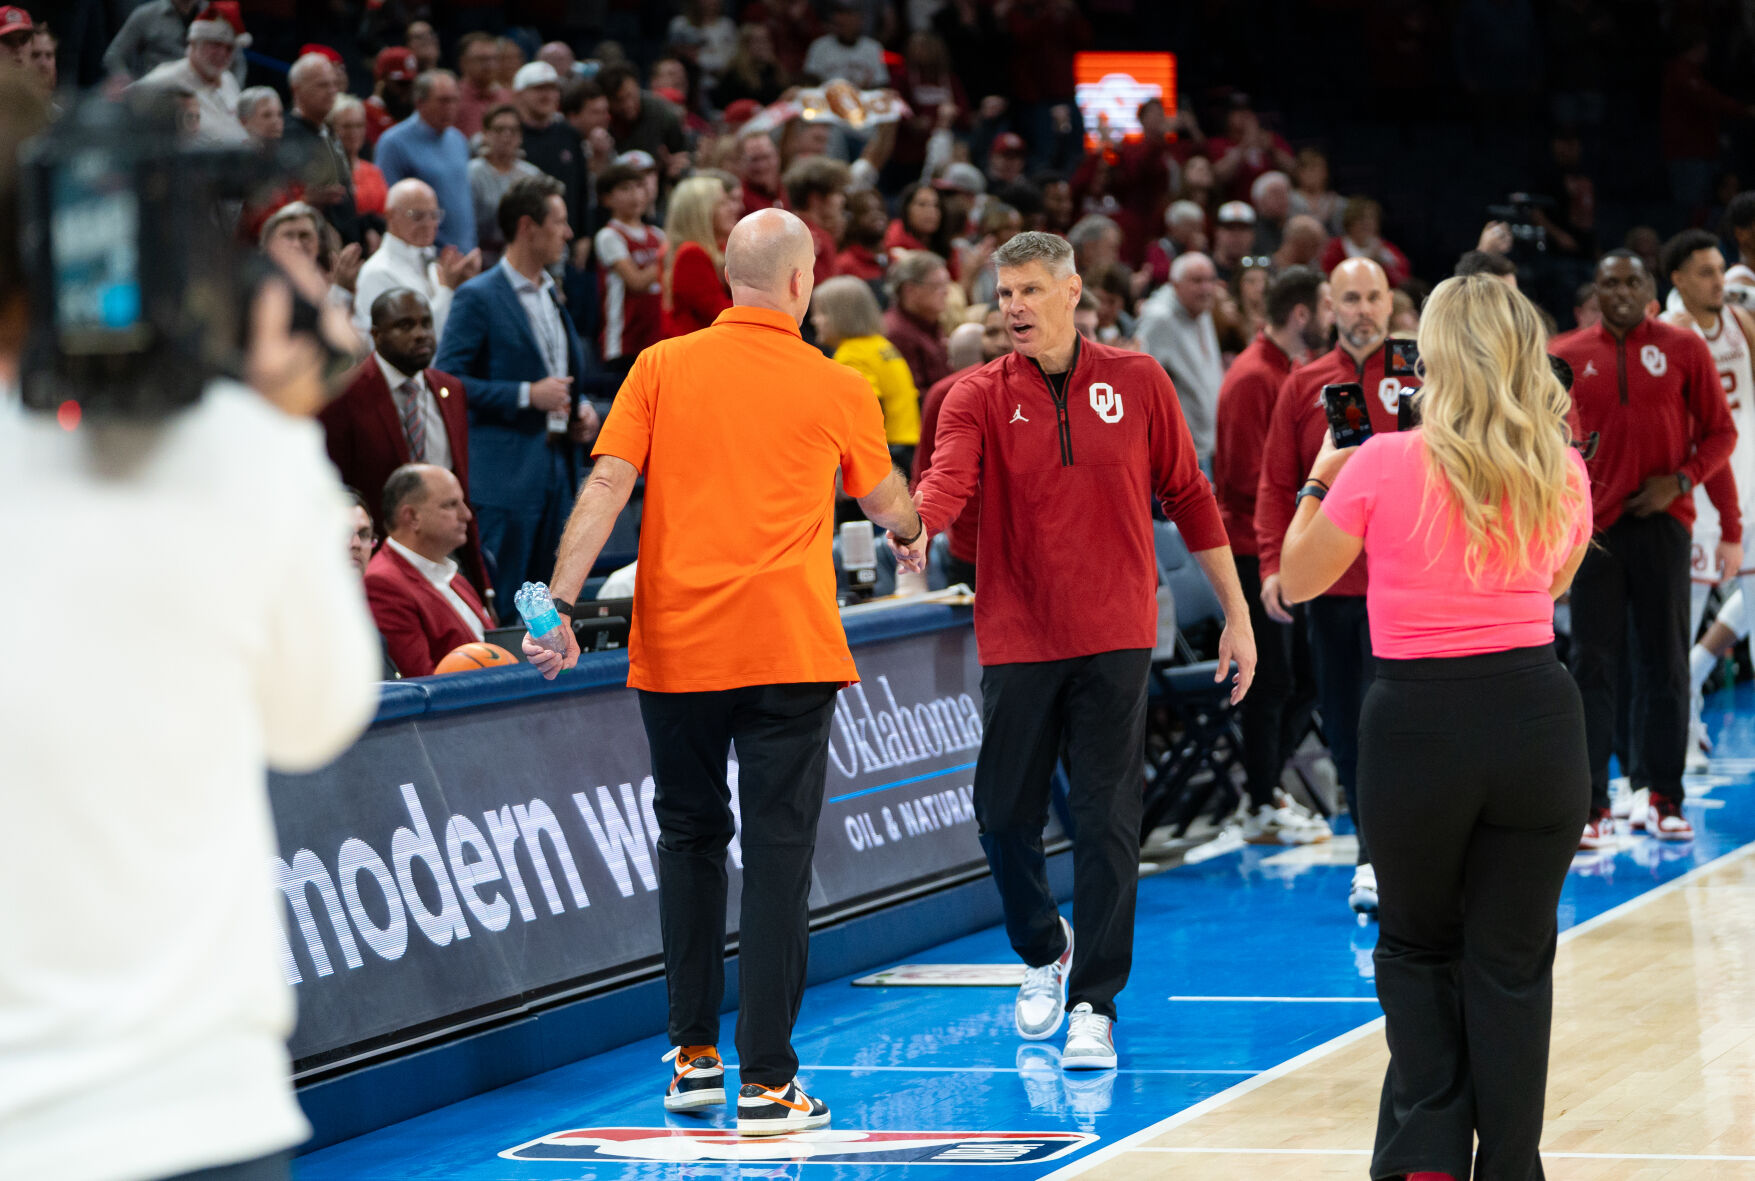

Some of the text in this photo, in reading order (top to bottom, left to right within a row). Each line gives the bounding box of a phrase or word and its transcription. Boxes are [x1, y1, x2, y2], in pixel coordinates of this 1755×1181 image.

[1089, 383, 1124, 423] OU
[845, 813, 884, 852] OIL
[882, 806, 901, 842] &
[273, 783, 590, 985] modern
